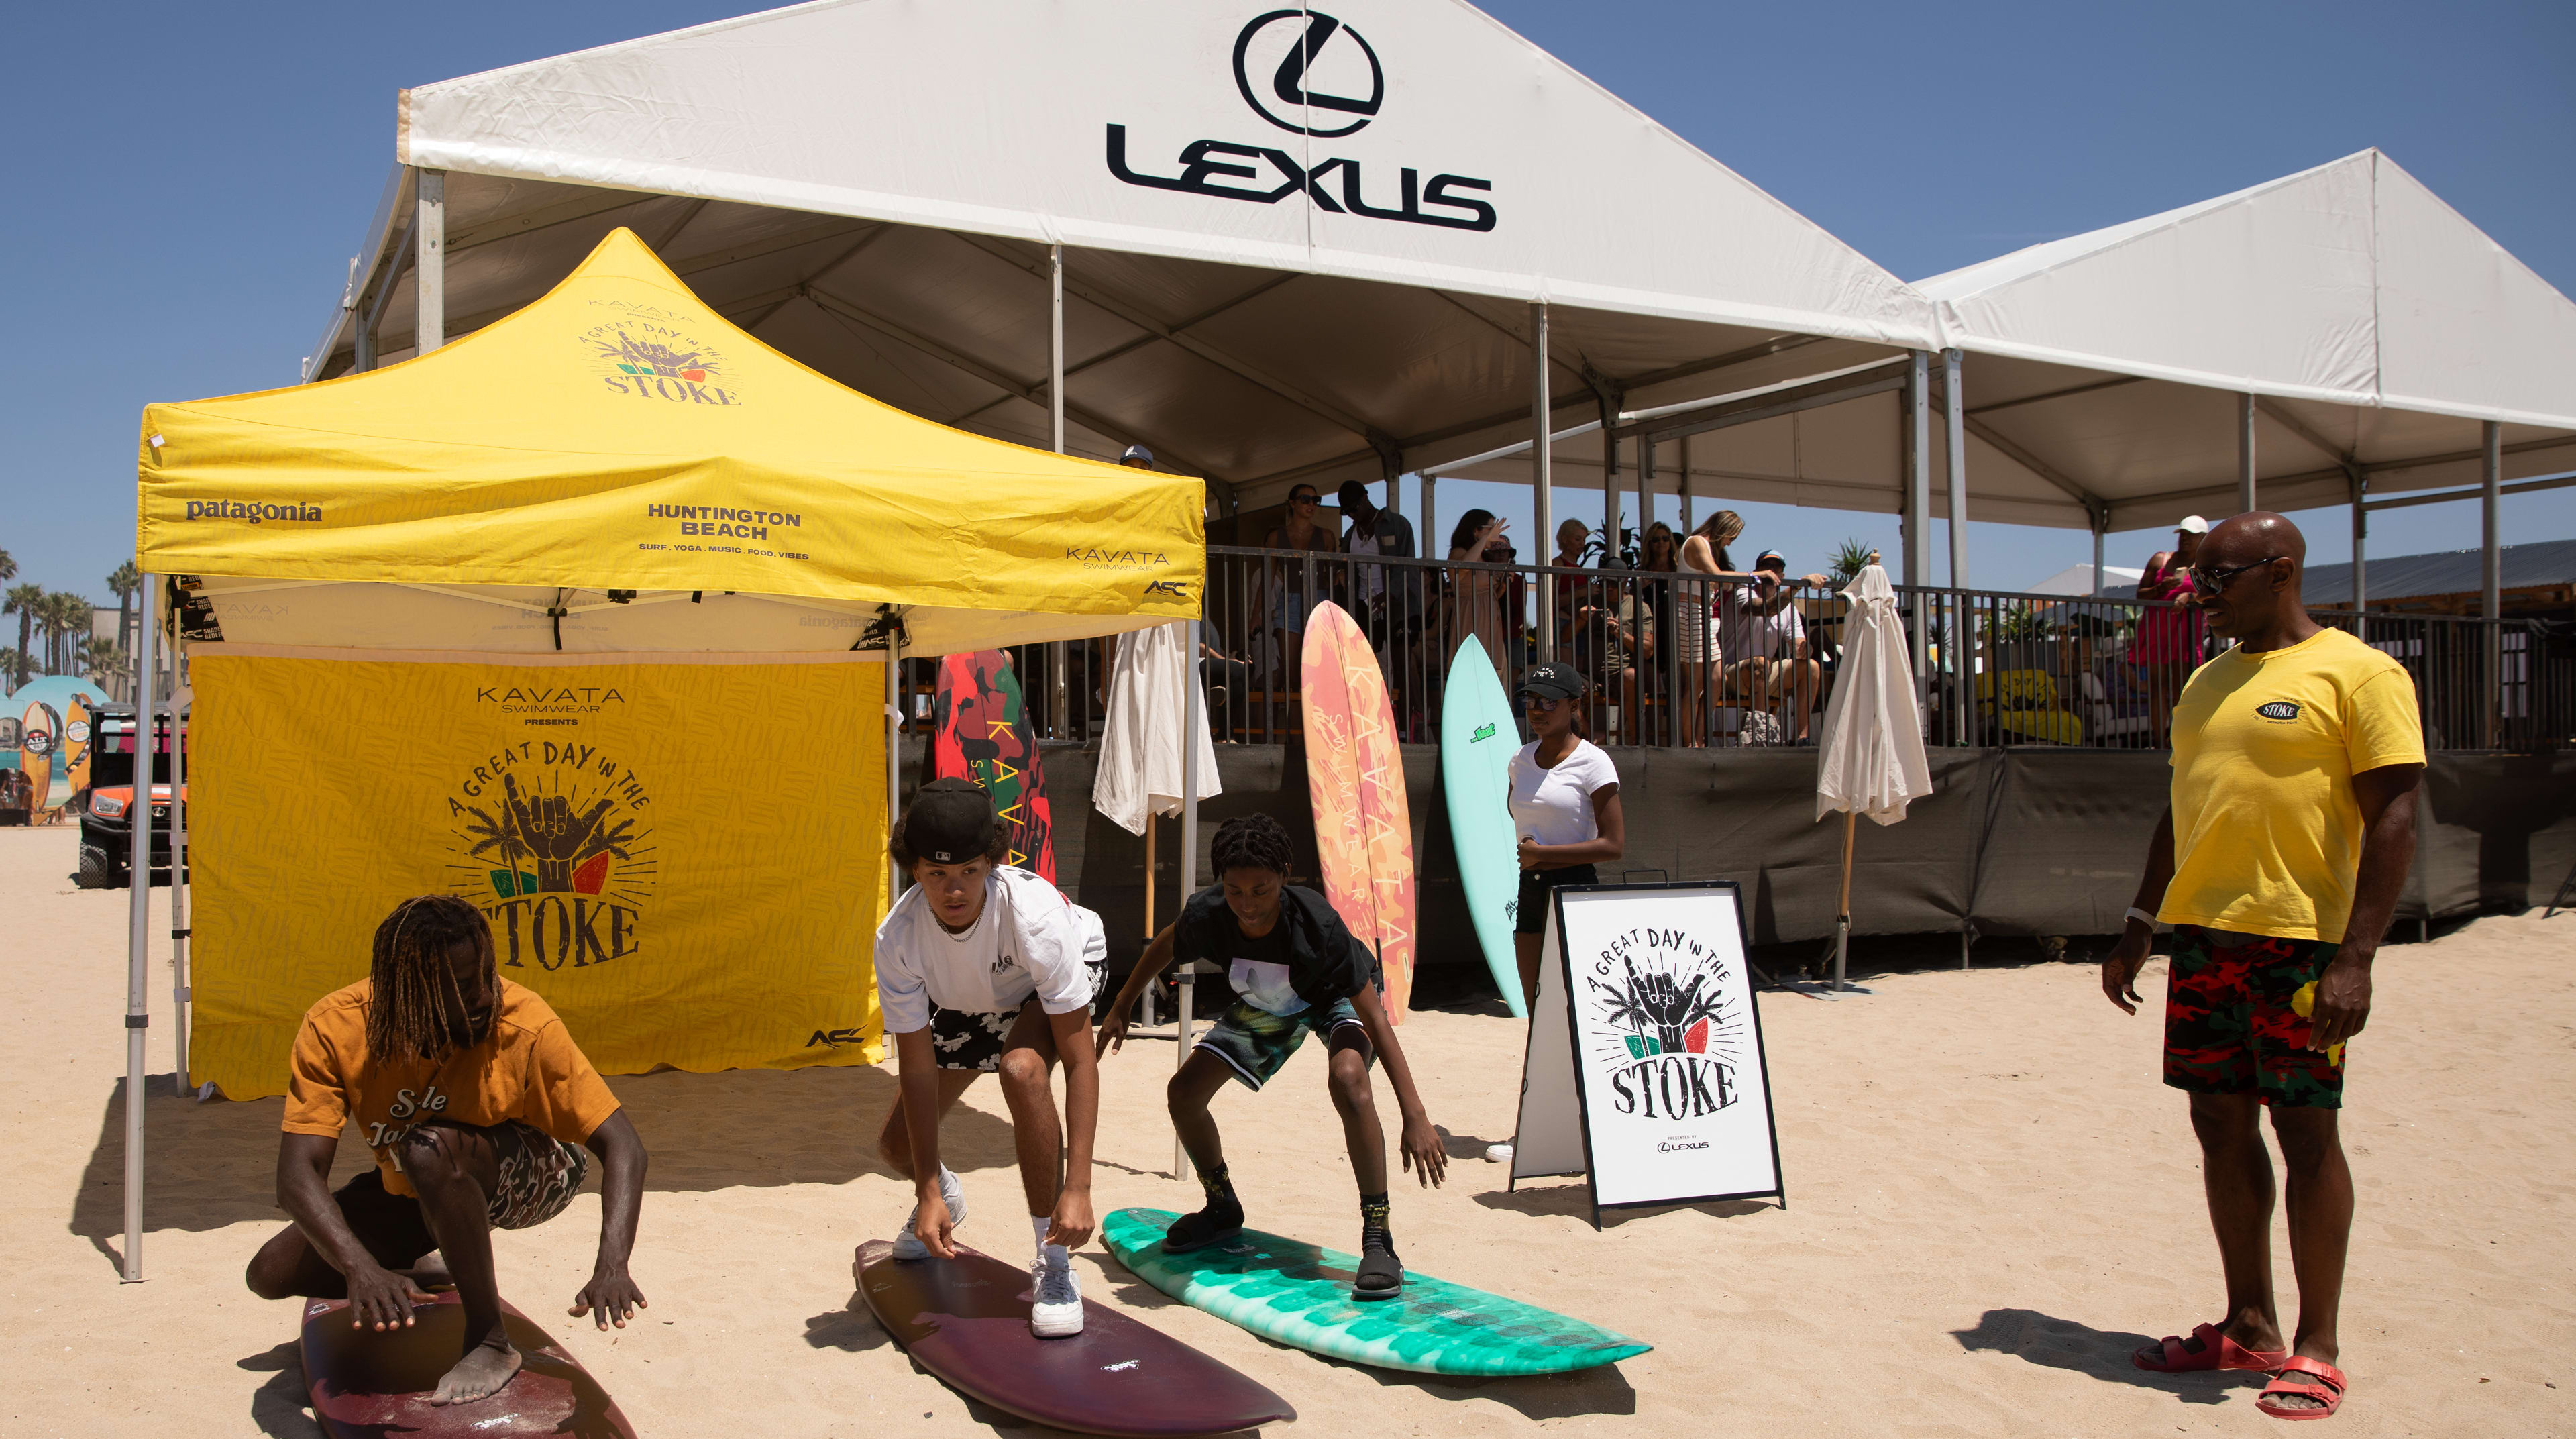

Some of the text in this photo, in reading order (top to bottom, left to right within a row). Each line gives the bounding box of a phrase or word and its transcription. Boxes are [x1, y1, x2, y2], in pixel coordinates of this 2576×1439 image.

[1106, 123, 1497, 232] LEXUS
[588, 299, 696, 323] KAVATA
[578, 321, 729, 361] A GREAT DAY IN THE
[604, 376, 742, 406] STOKE
[186, 498, 323, 525] patagonia
[648, 504, 800, 527] HUNTINGTON
[681, 521, 767, 541] BEACH
[708, 546, 742, 554] MUSIC
[778, 552, 809, 561] VIBES
[1066, 547, 1171, 566] KAVATA
[1083, 562, 1154, 572] SWIMWEAR
[1143, 580, 1187, 597] ASC
[477, 686, 625, 704] KAVATA
[502, 704, 600, 713] SWIMWEAR
[2263, 704, 2295, 717] STOKE
[448, 741, 651, 818] A GREAT DAY IN THE
[987, 721, 1028, 866] KAVA
[1329, 713, 1365, 901] SWIMWEAR
[1346, 665, 1408, 949] KAVATA
[480, 894, 639, 971] TOKE
[1587, 928, 1731, 993] A GREAT DAY IN THE
[1613, 1055, 1739, 1121] STOKE
[390, 1086, 447, 1118] Sle
[1671, 1142, 1709, 1151] LEXUS
